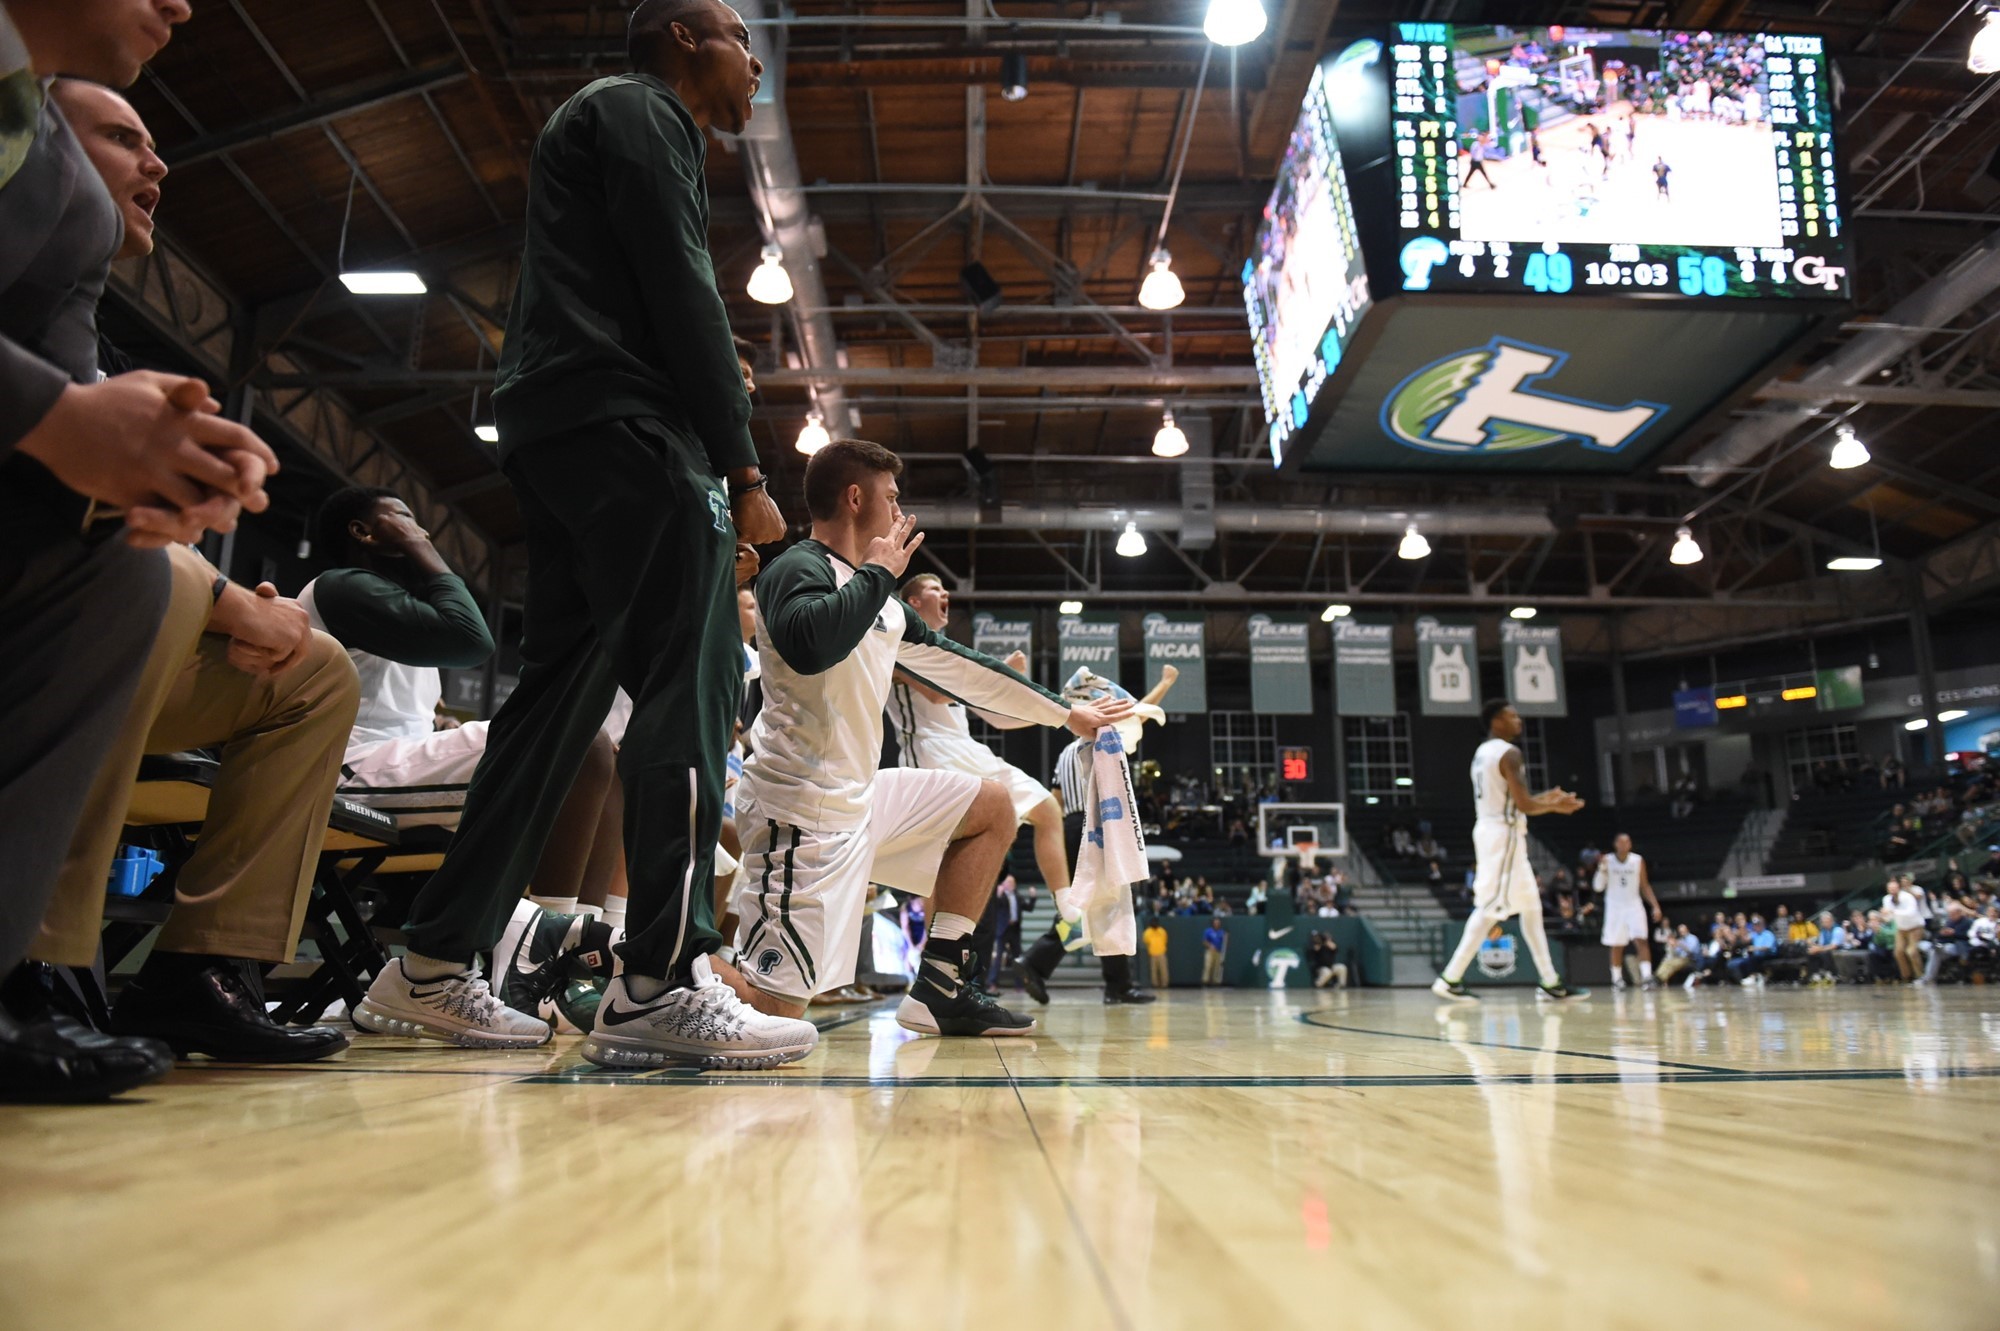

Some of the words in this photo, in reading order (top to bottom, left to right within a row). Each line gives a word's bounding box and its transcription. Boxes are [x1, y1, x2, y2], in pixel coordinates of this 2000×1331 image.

[1399, 23, 1446, 42] WAVE
[1494, 255, 1509, 278] 2
[1523, 253, 1573, 293] 49
[1585, 262, 1668, 286] 10:03
[1678, 256, 1727, 296] 58
[1792, 256, 1845, 291] GT
[974, 617, 1031, 636] TULANE
[1060, 620, 1117, 638] TULANE
[1145, 619, 1202, 637] TULANE
[1251, 619, 1307, 639] TULANE
[1063, 646, 1115, 662] WNIT
[1149, 643, 1201, 658] NCAA
[1284, 759, 1306, 779] 30
